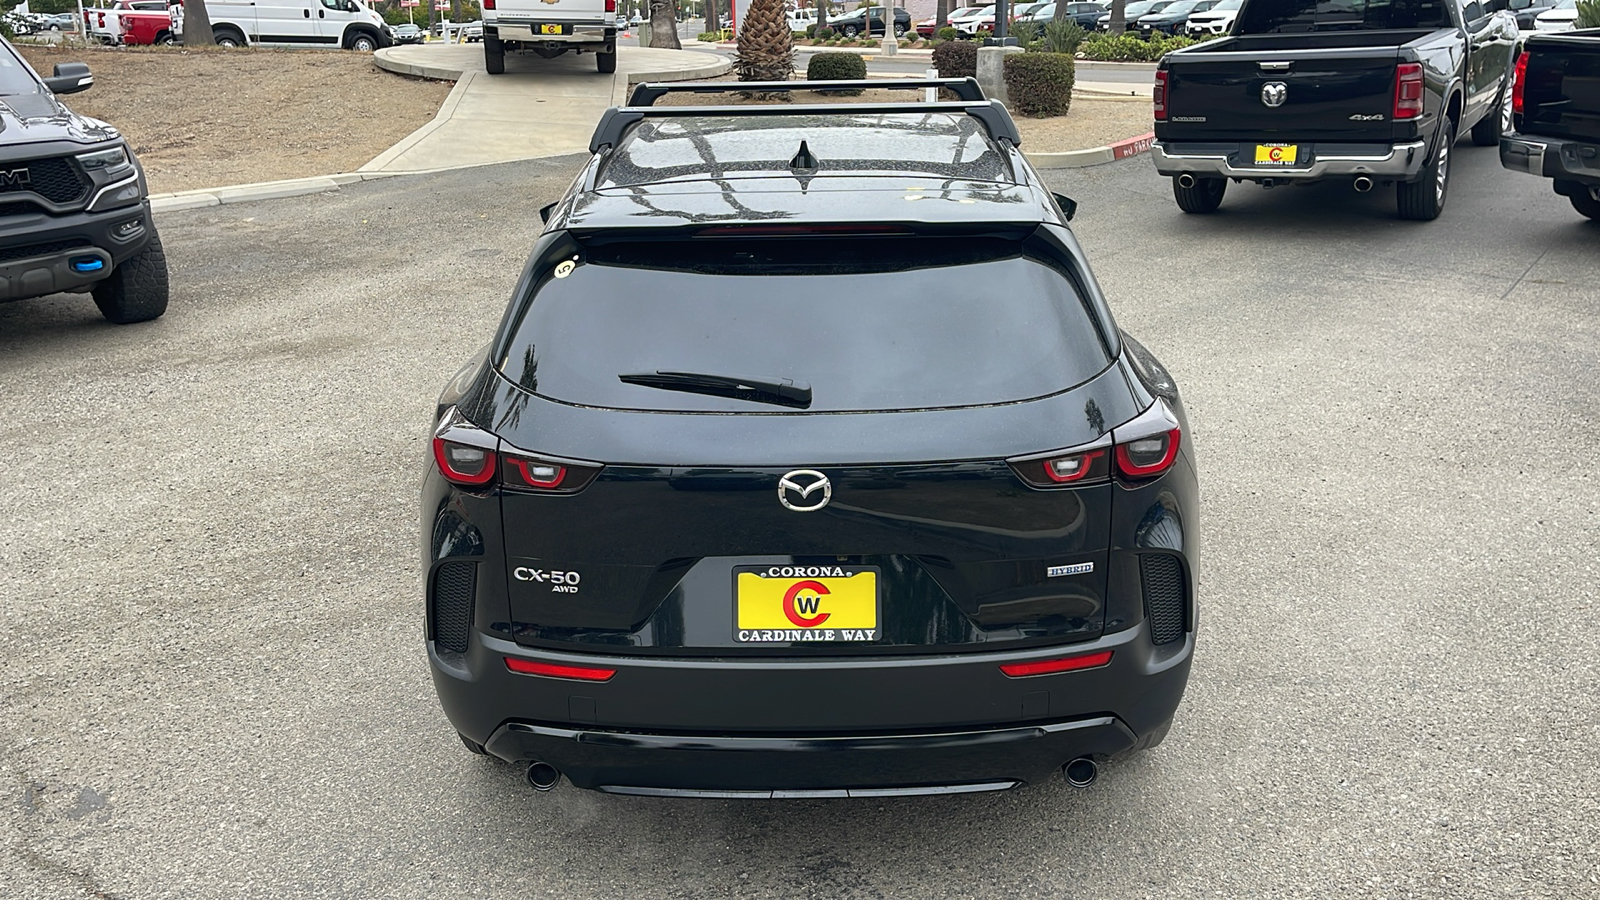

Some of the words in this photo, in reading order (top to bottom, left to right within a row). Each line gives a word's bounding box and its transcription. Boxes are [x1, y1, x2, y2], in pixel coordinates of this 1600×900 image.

[513, 566, 581, 585] CX-50
[768, 566, 845, 577] CORONA
[1051, 564, 1092, 575] HYBRID
[551, 585, 579, 594] AWD
[782, 579, 831, 628] C
[797, 595, 821, 614] W
[738, 629, 835, 642] CARDINALE
[842, 629, 876, 641] WAY
